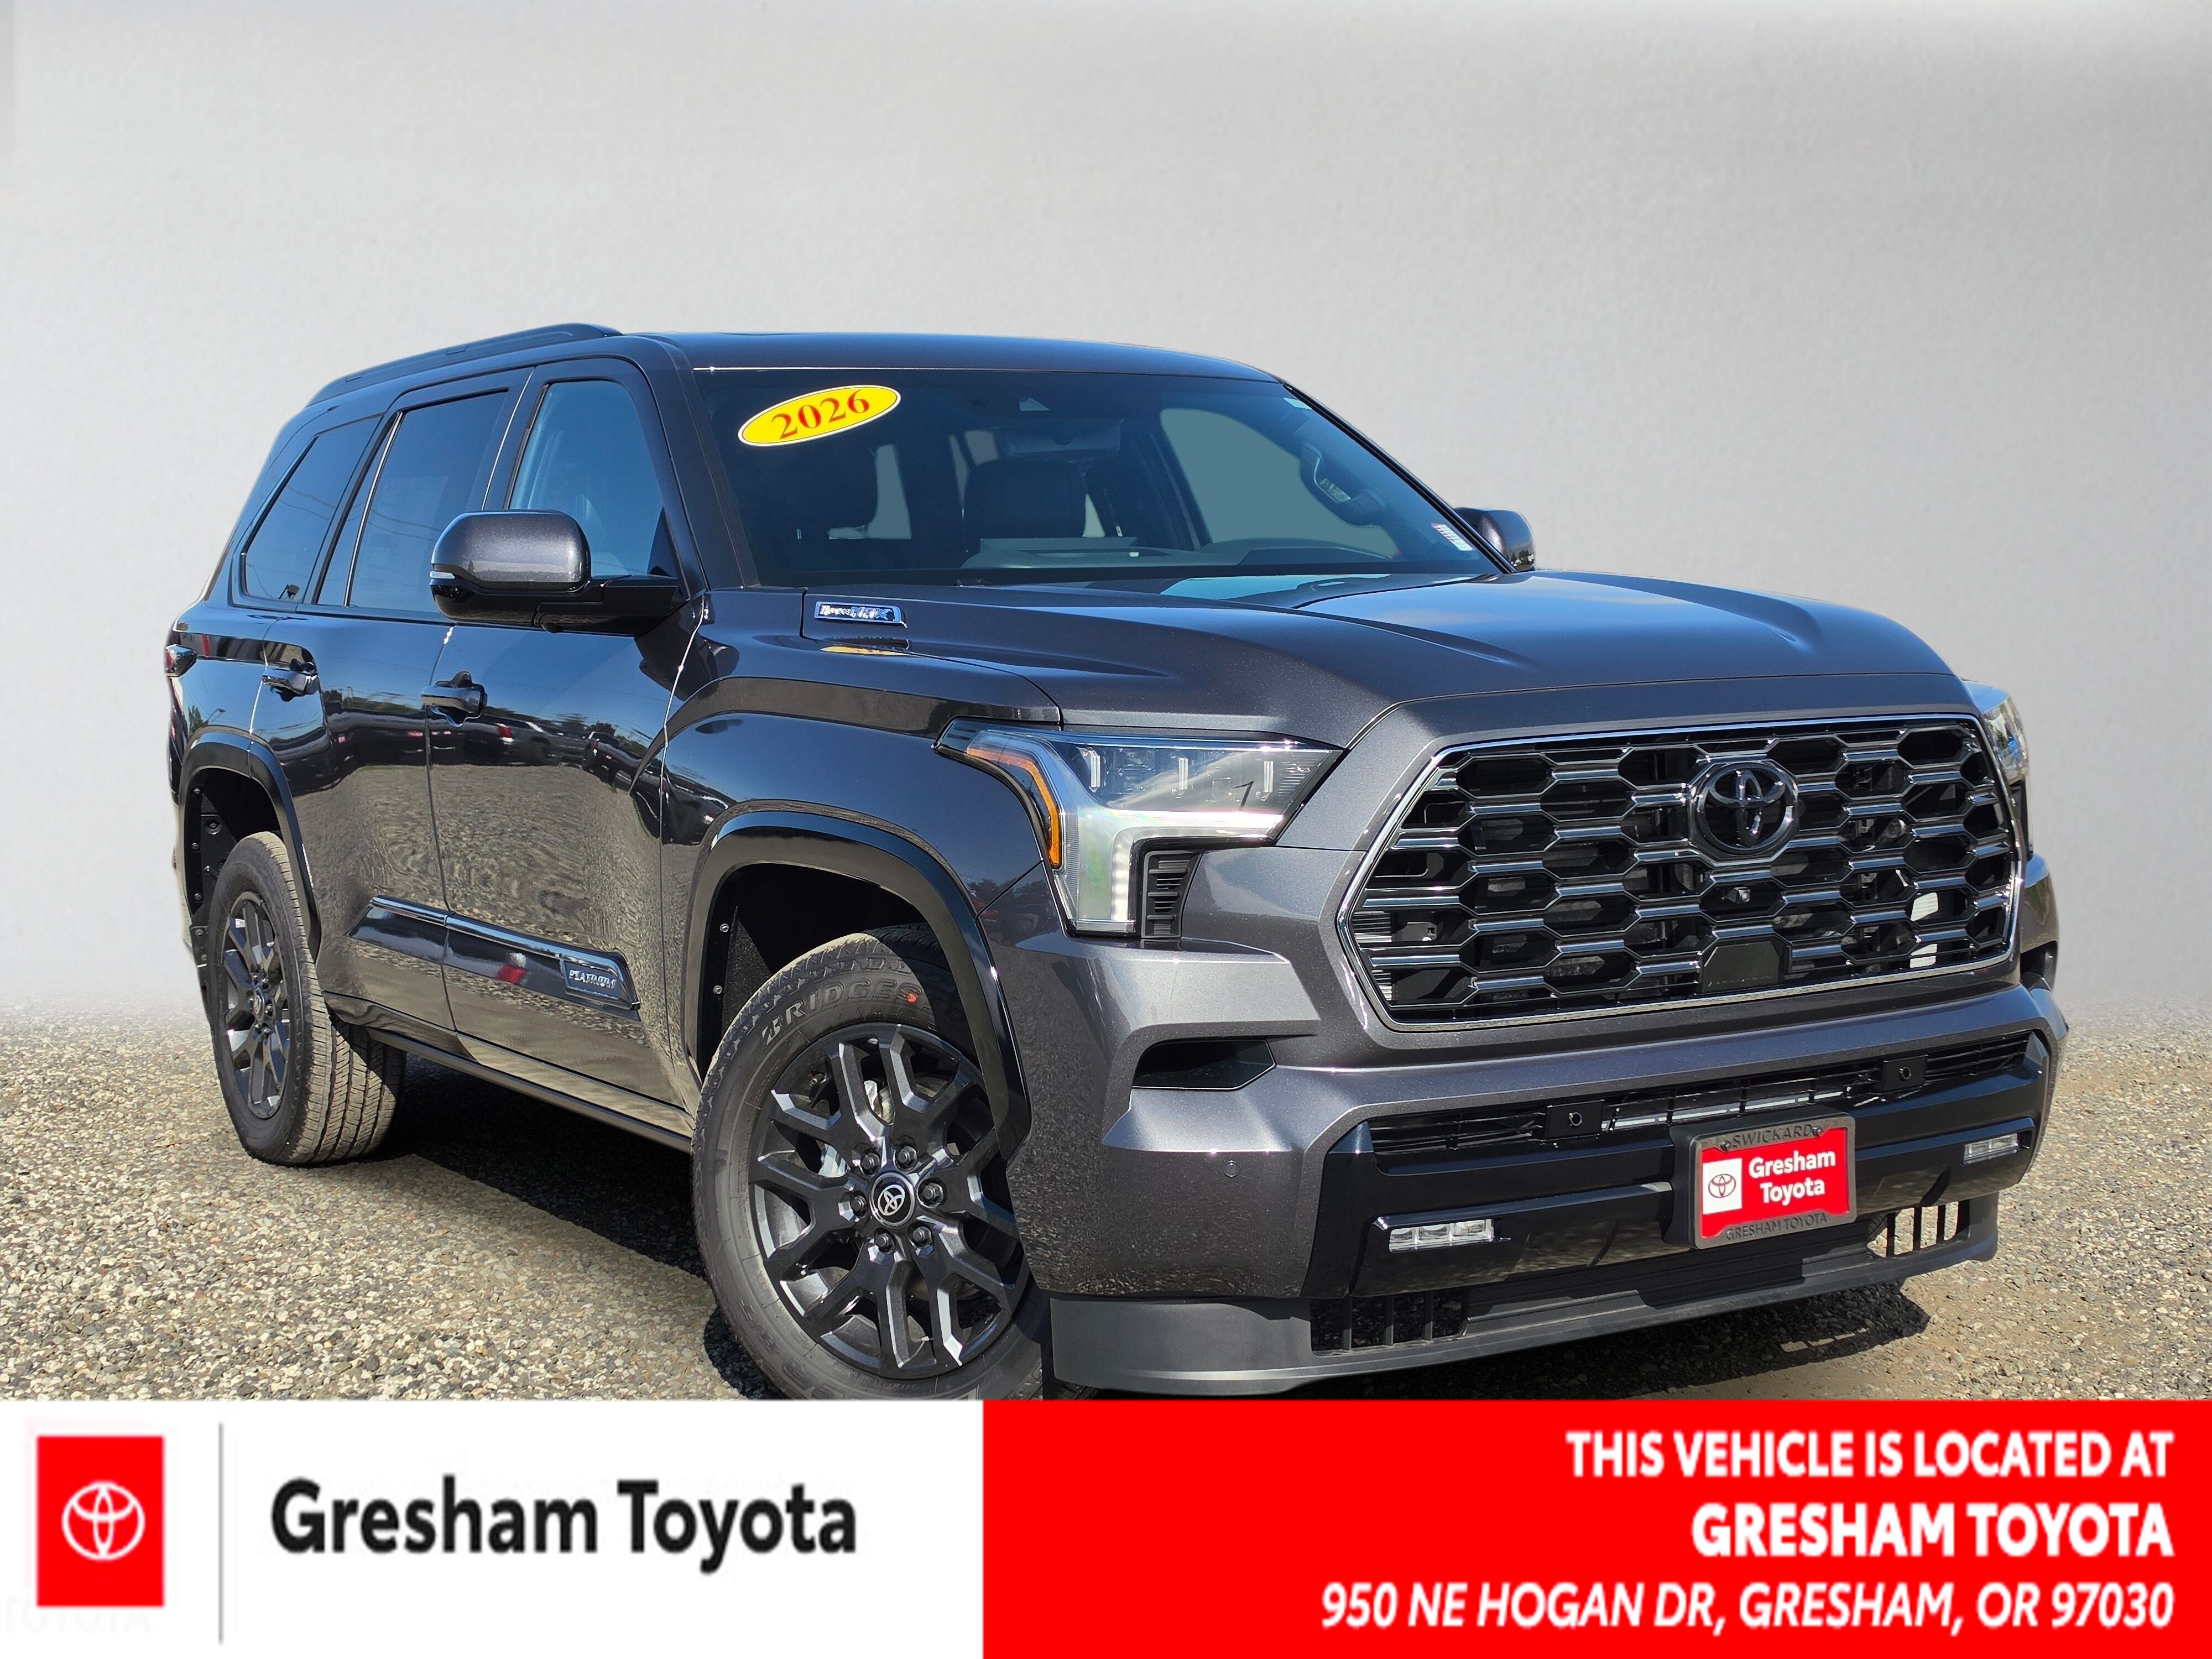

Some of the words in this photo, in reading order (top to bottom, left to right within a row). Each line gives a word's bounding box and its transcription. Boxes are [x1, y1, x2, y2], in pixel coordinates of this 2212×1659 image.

[771, 389, 870, 440] 2026
[761, 978, 924, 1047] BRIDGES
[1731, 1124, 1813, 1148] SWICKARD
[1748, 1150, 1837, 1178] Gresham
[1759, 1176, 1826, 1206] Toyota
[1725, 1219, 1782, 1241] GRESHAM
[1783, 1212, 1828, 1229] TOYOTA
